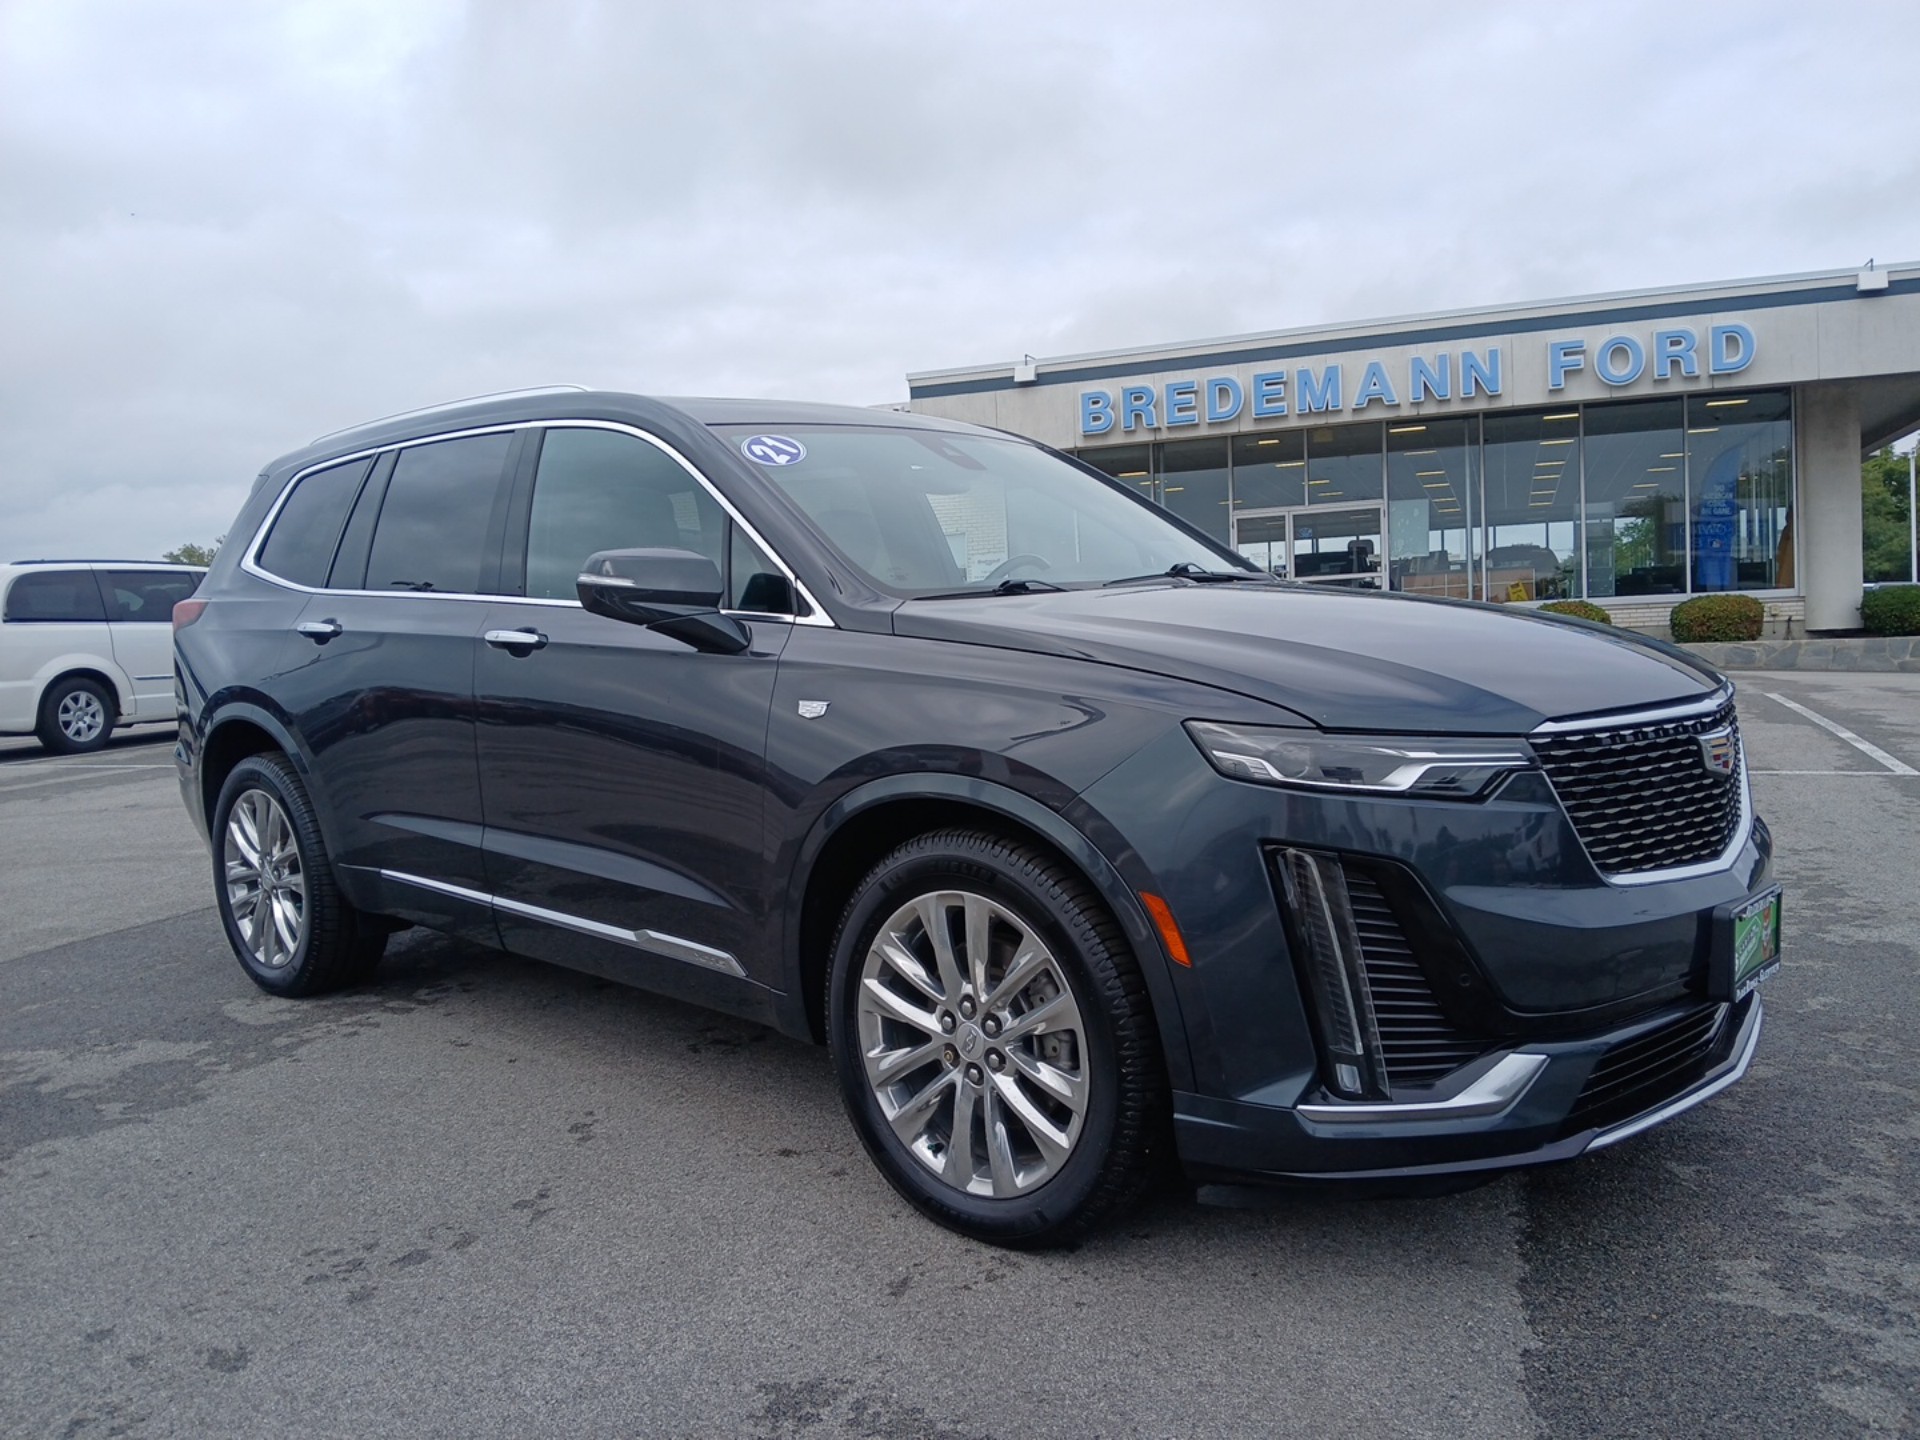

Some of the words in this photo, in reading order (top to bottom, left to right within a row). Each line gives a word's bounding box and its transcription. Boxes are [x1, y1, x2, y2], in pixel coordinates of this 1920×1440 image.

[1080, 346, 1502, 436] BREDEMANN
[1548, 320, 1757, 391] FORD
[750, 436, 799, 464] 21
